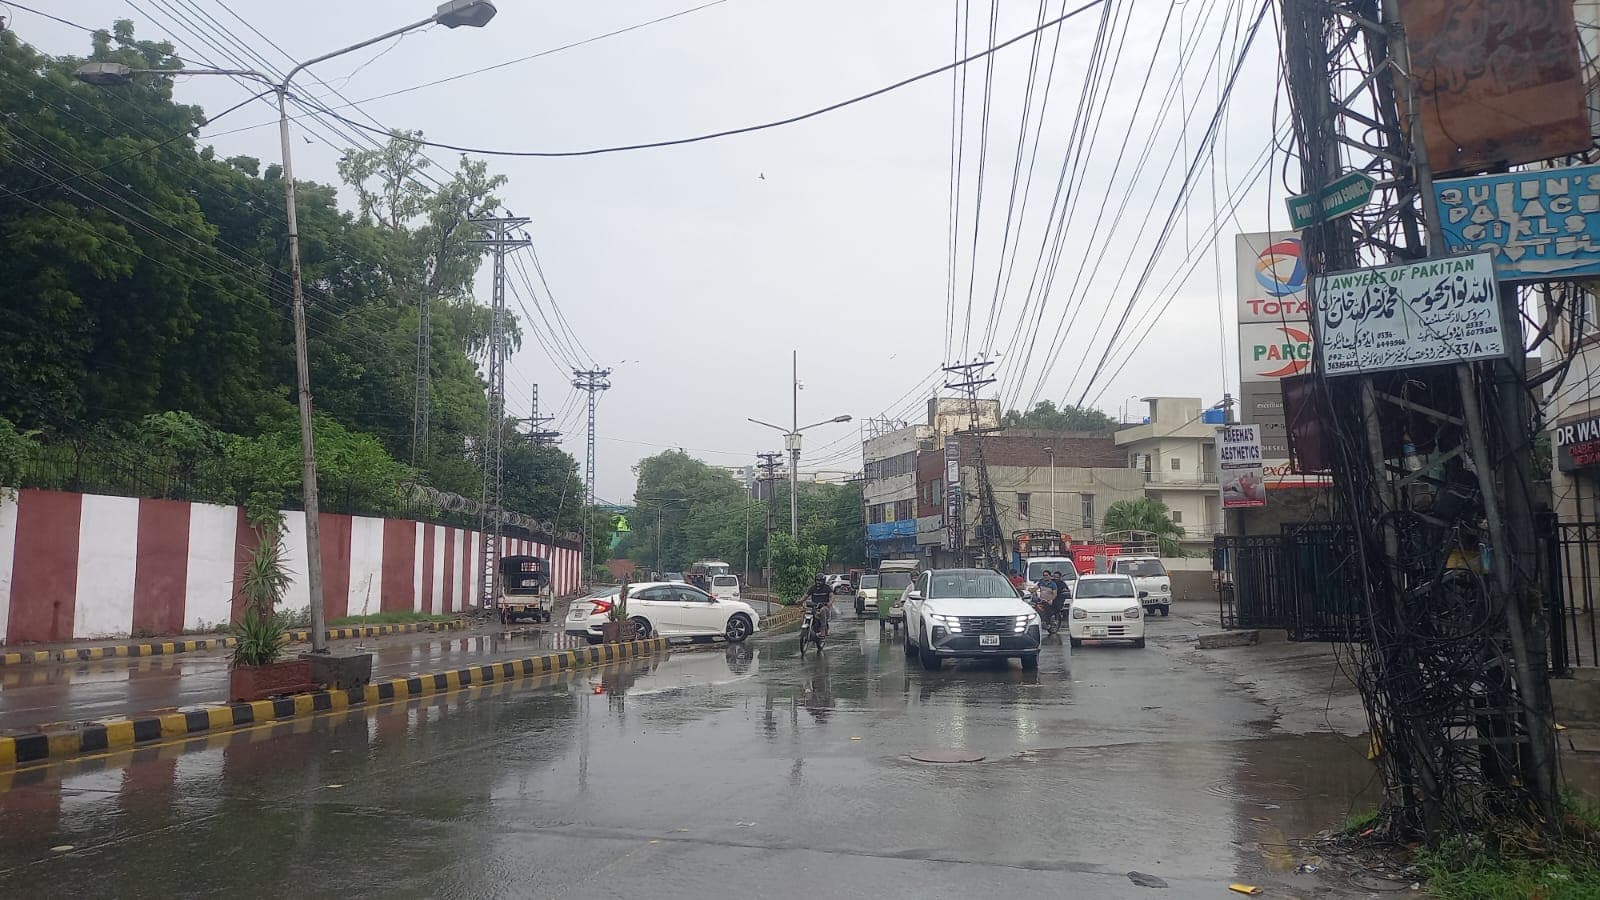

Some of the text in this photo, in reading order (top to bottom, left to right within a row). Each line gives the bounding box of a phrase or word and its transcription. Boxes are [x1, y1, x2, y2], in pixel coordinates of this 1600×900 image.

[1462, 214, 1586, 241] GIRLS
[1391, 268, 1407, 282] OF
[1411, 259, 1475, 280] PAKITAN
[1247, 299, 1312, 316] TOTA
[1253, 343, 1312, 361] PARC
[1556, 418, 1600, 447] DR WA
[1221, 445, 1259, 460] AESTHETICS
